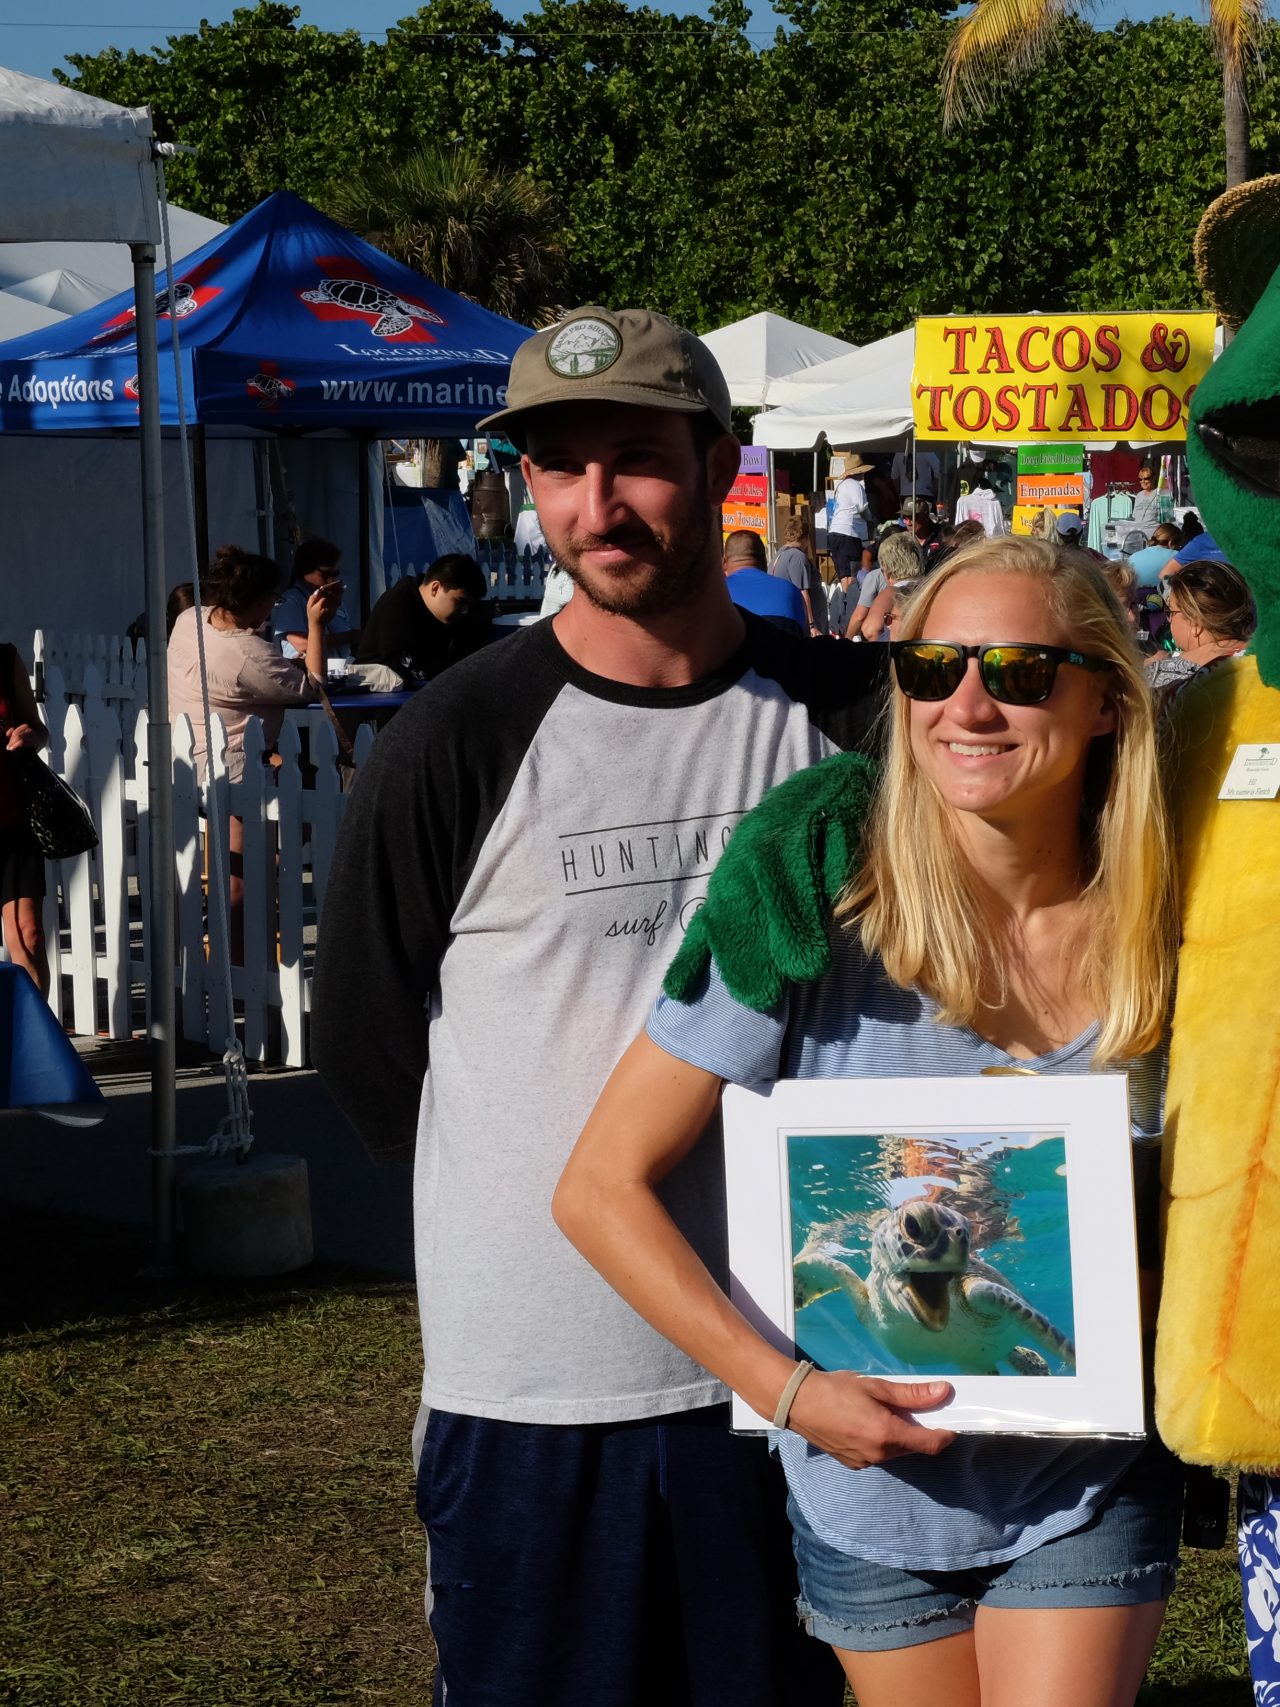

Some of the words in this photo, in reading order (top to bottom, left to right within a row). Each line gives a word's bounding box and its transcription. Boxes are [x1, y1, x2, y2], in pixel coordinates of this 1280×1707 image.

[943, 325, 1122, 374] TACOS
[1139, 322, 1190, 373] &
[7, 373, 115, 410] Adoptions
[743, 452, 763, 467] Bowl
[1020, 482, 1081, 501] Empanadas
[604, 899, 668, 946] surf
